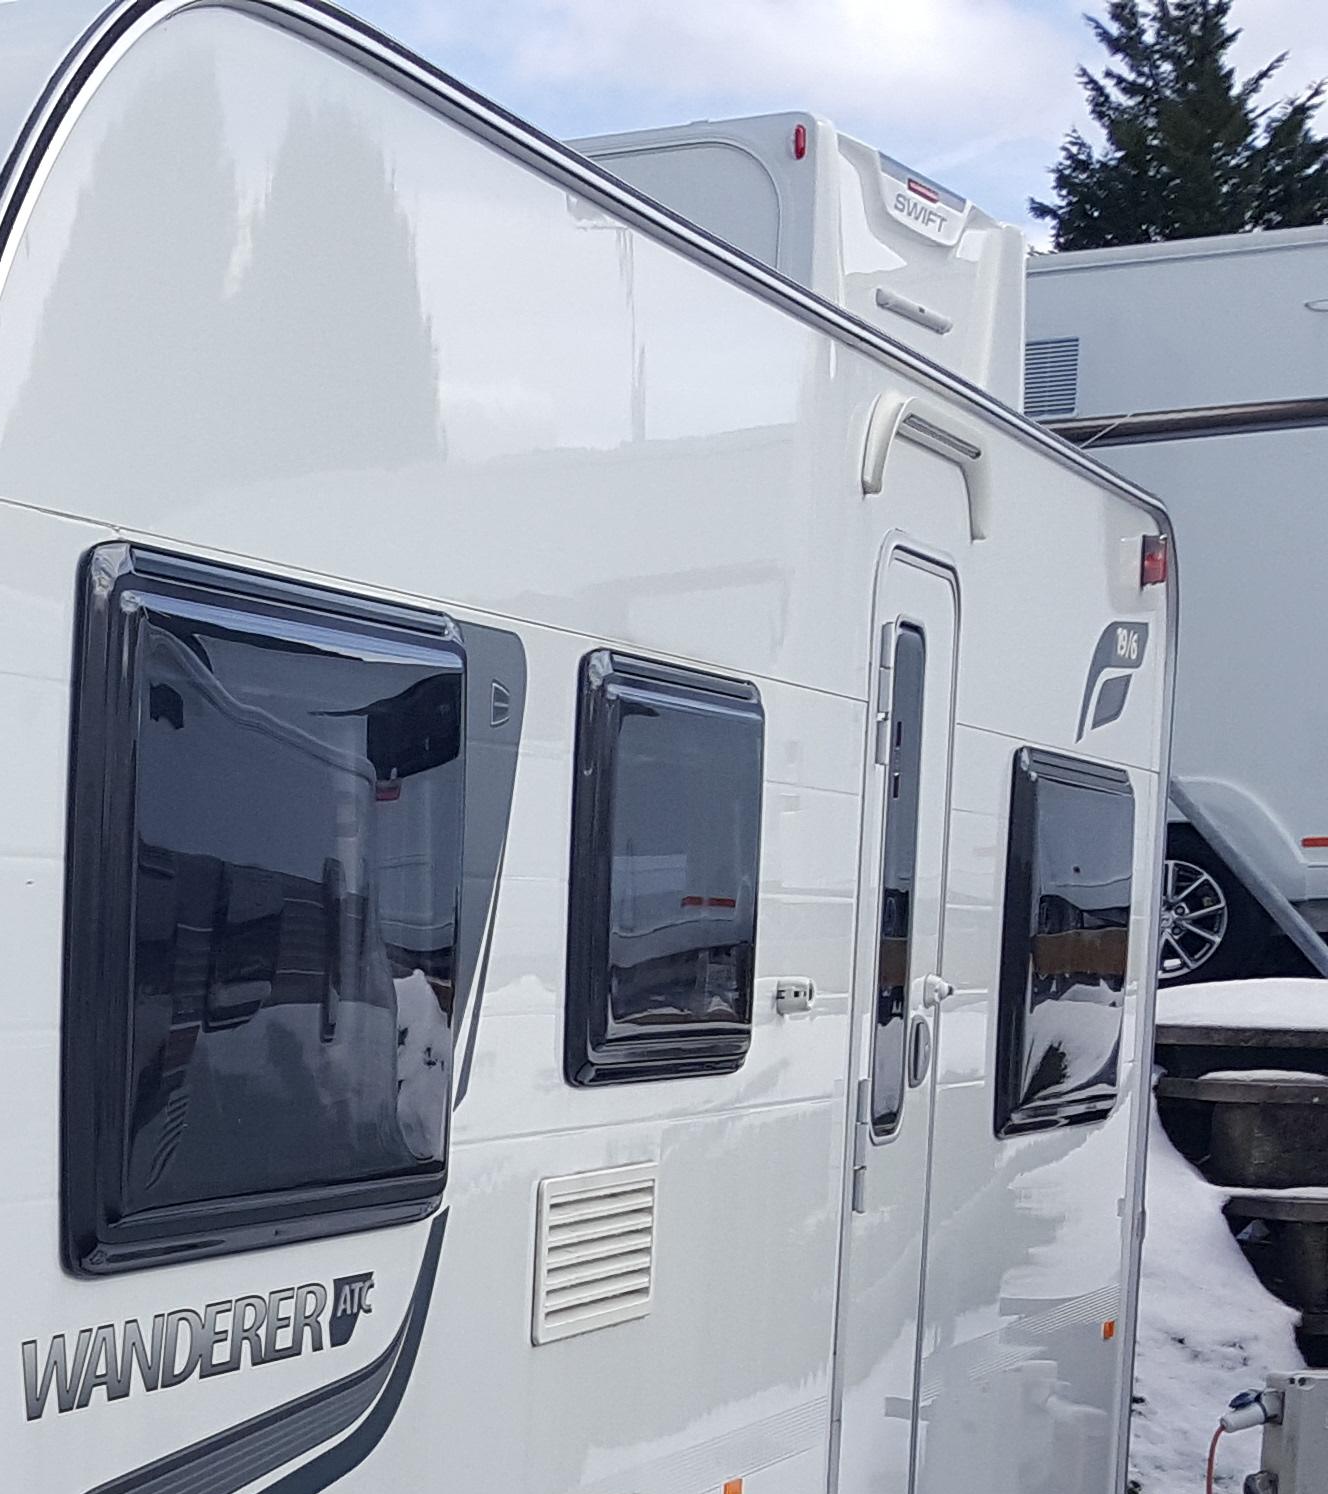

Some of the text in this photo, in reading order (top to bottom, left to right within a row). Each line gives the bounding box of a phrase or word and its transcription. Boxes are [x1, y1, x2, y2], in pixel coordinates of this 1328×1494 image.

[894, 192, 948, 233] SWIFT
[20, 1279, 376, 1422] WANDERER ATC
